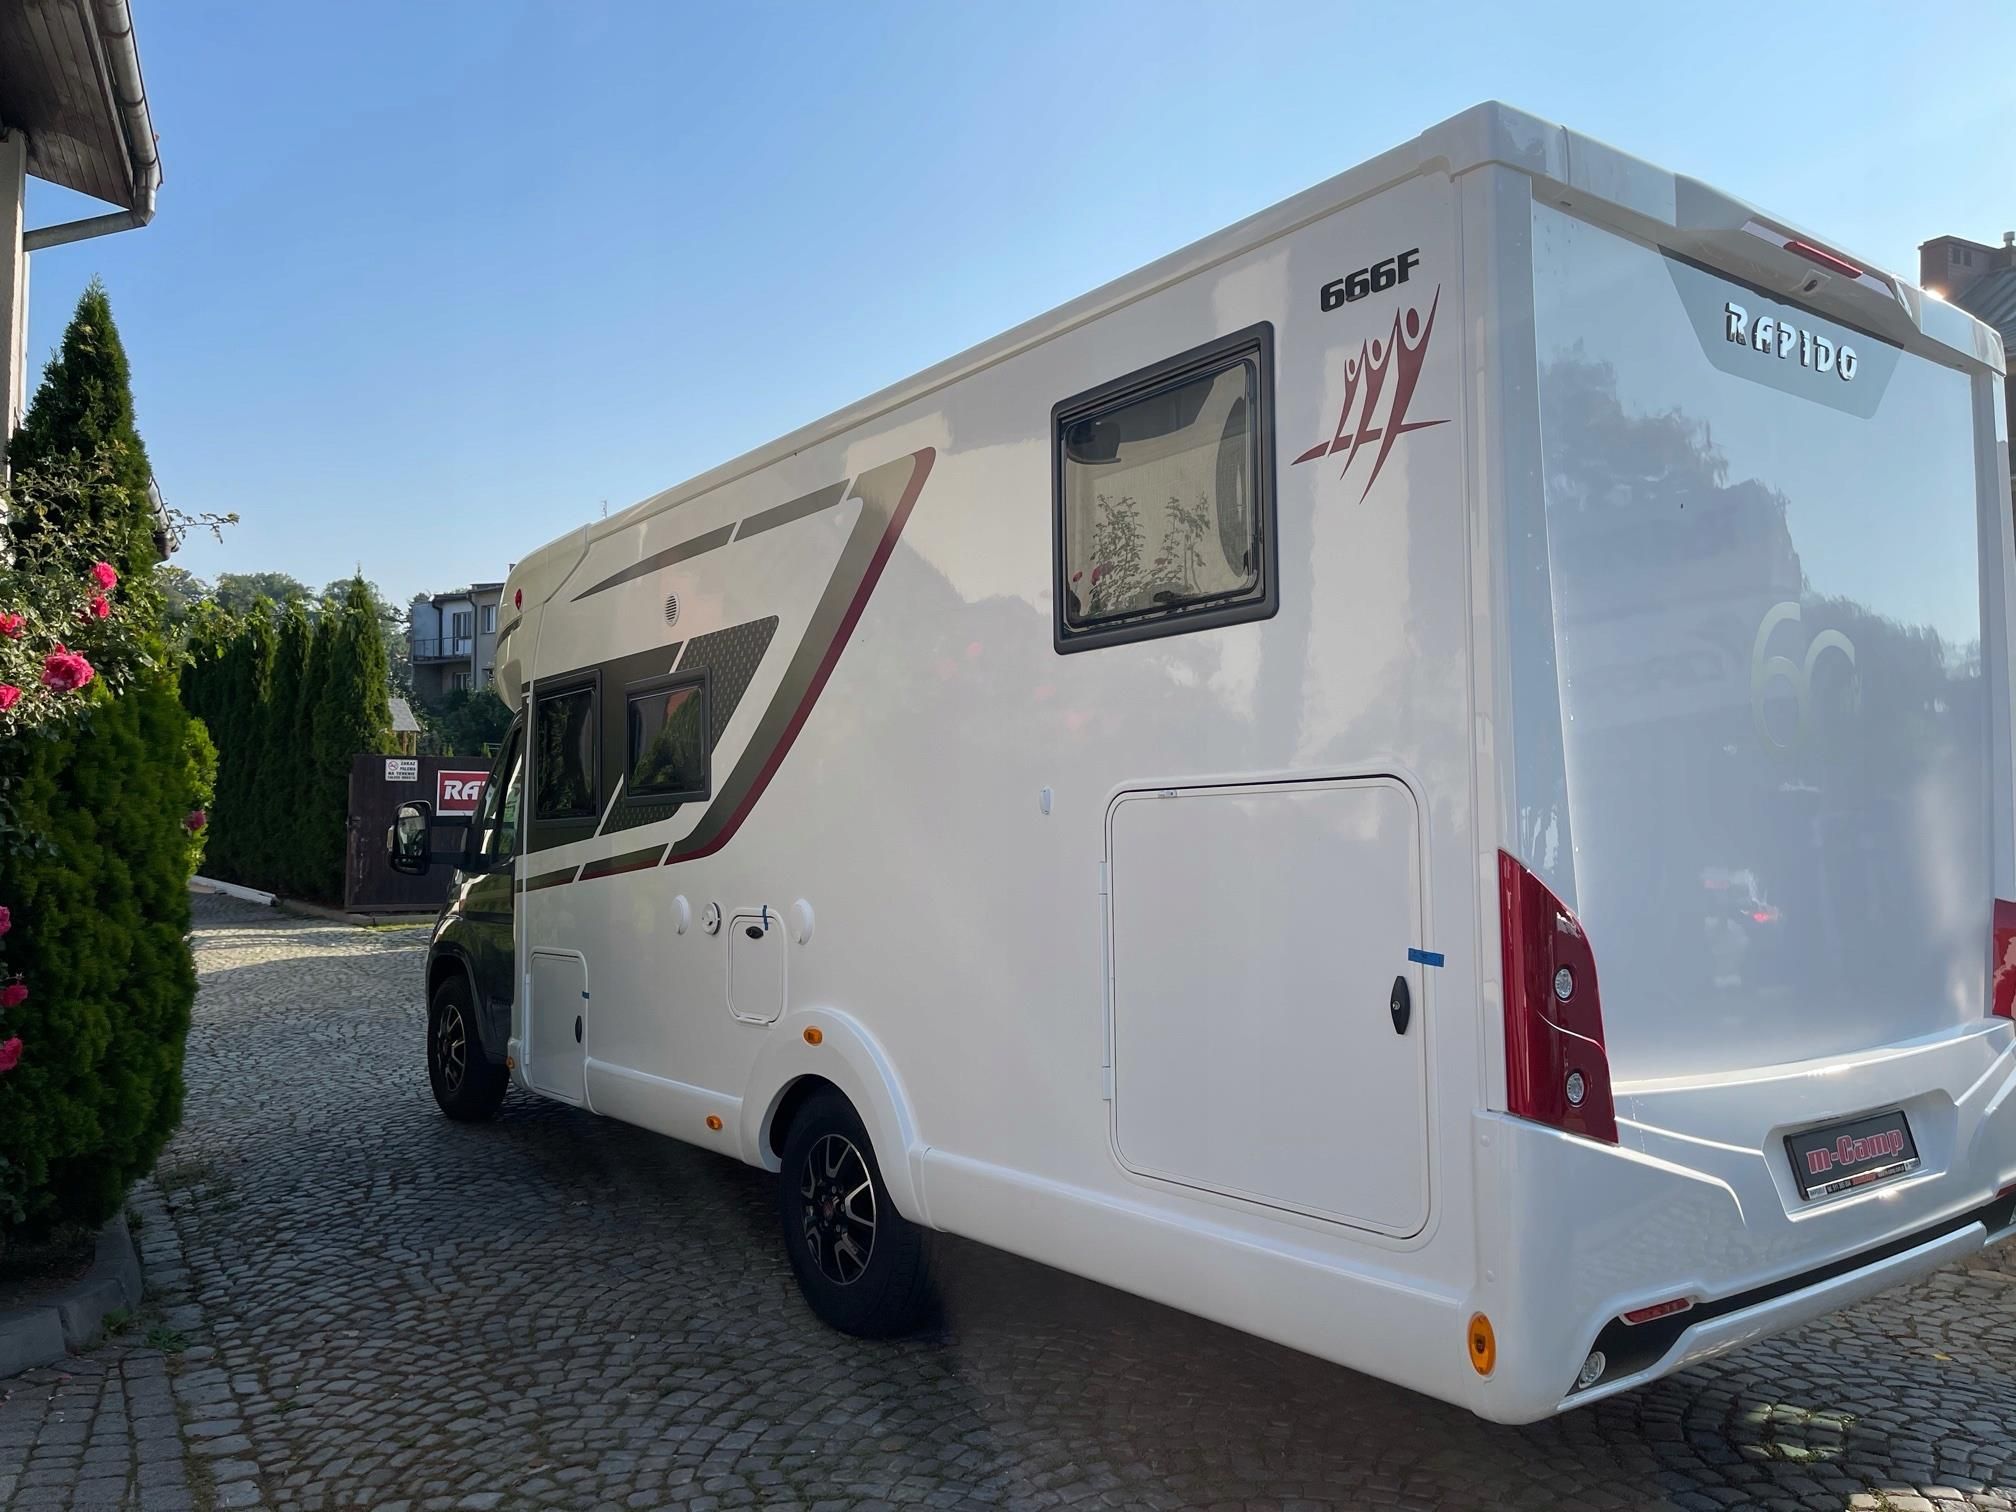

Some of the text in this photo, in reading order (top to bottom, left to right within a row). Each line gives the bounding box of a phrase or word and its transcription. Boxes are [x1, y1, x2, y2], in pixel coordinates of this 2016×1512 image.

[1320, 247, 1420, 313] 666F
[1725, 302, 1858, 381] RAPIDO
[1806, 1129, 1904, 1174] m-Camp
